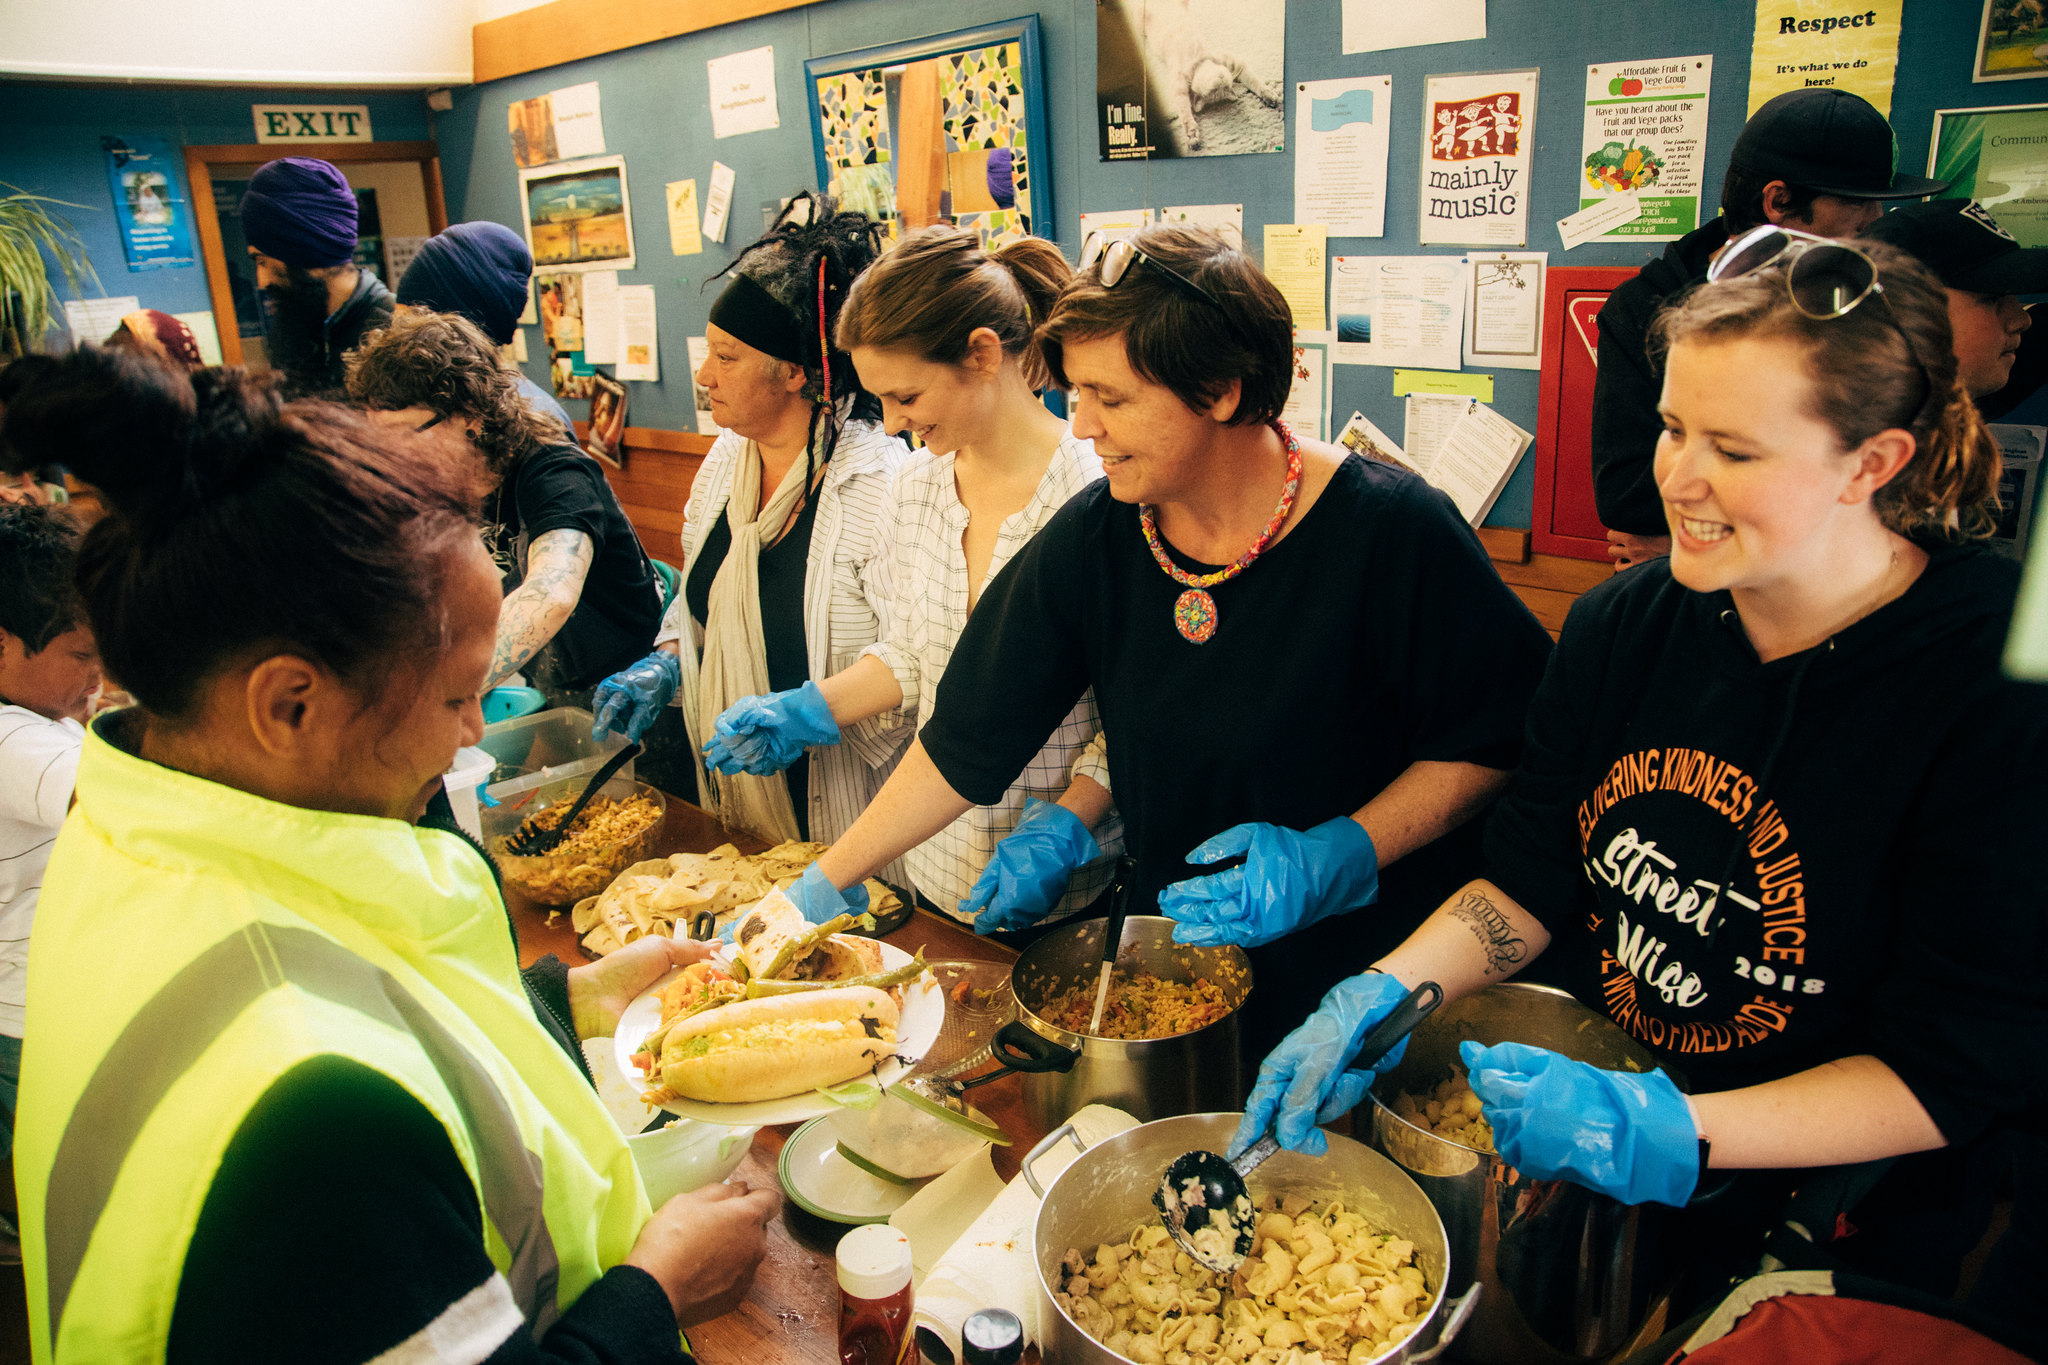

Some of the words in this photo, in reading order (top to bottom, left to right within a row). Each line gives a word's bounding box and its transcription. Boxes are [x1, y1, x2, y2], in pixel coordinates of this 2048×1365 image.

[1779, 10, 1877, 34] Respect
[1622, 67, 1660, 76] Affordable
[1661, 65, 1679, 74] Fruit
[1680, 64, 1687, 72] &
[1776, 65, 1795, 74] It's
[1798, 62, 1829, 72] what
[1832, 61, 1850, 69] we
[1853, 59, 1868, 68] do
[1644, 76, 1662, 86] Vege
[1665, 75, 1687, 84] Group
[1805, 76, 1835, 87] here!
[1107, 104, 1123, 124] I'm
[1124, 103, 1146, 123] fine.
[1595, 107, 1612, 116] Have
[1615, 107, 1629, 116] you
[1631, 104, 1653, 114] heard
[1655, 103, 1677, 112] about
[1680, 102, 1693, 111] the
[1603, 117, 1620, 126] Fruit
[1622, 117, 1636, 125] and
[1638, 116, 1657, 125] Vege
[1660, 114, 1683, 125] packs
[263, 112, 361, 136] EXIT
[1108, 124, 1138, 147] Really.
[1604, 128, 1619, 137] that
[1621, 128, 1633, 136] our
[1635, 127, 1658, 137] group
[1660, 124, 1684, 134] does?
[1428, 161, 1518, 192] mainly
[1428, 188, 1516, 220] music
[1658, 748, 1759, 824] KINDNESS
[1755, 852, 1807, 965] JUSTICE
[1591, 827, 1762, 937] Street
[1617, 910, 1709, 1008] Wise
[1734, 956, 1826, 994] 2018
[1632, 1009, 1665, 1046] NO
